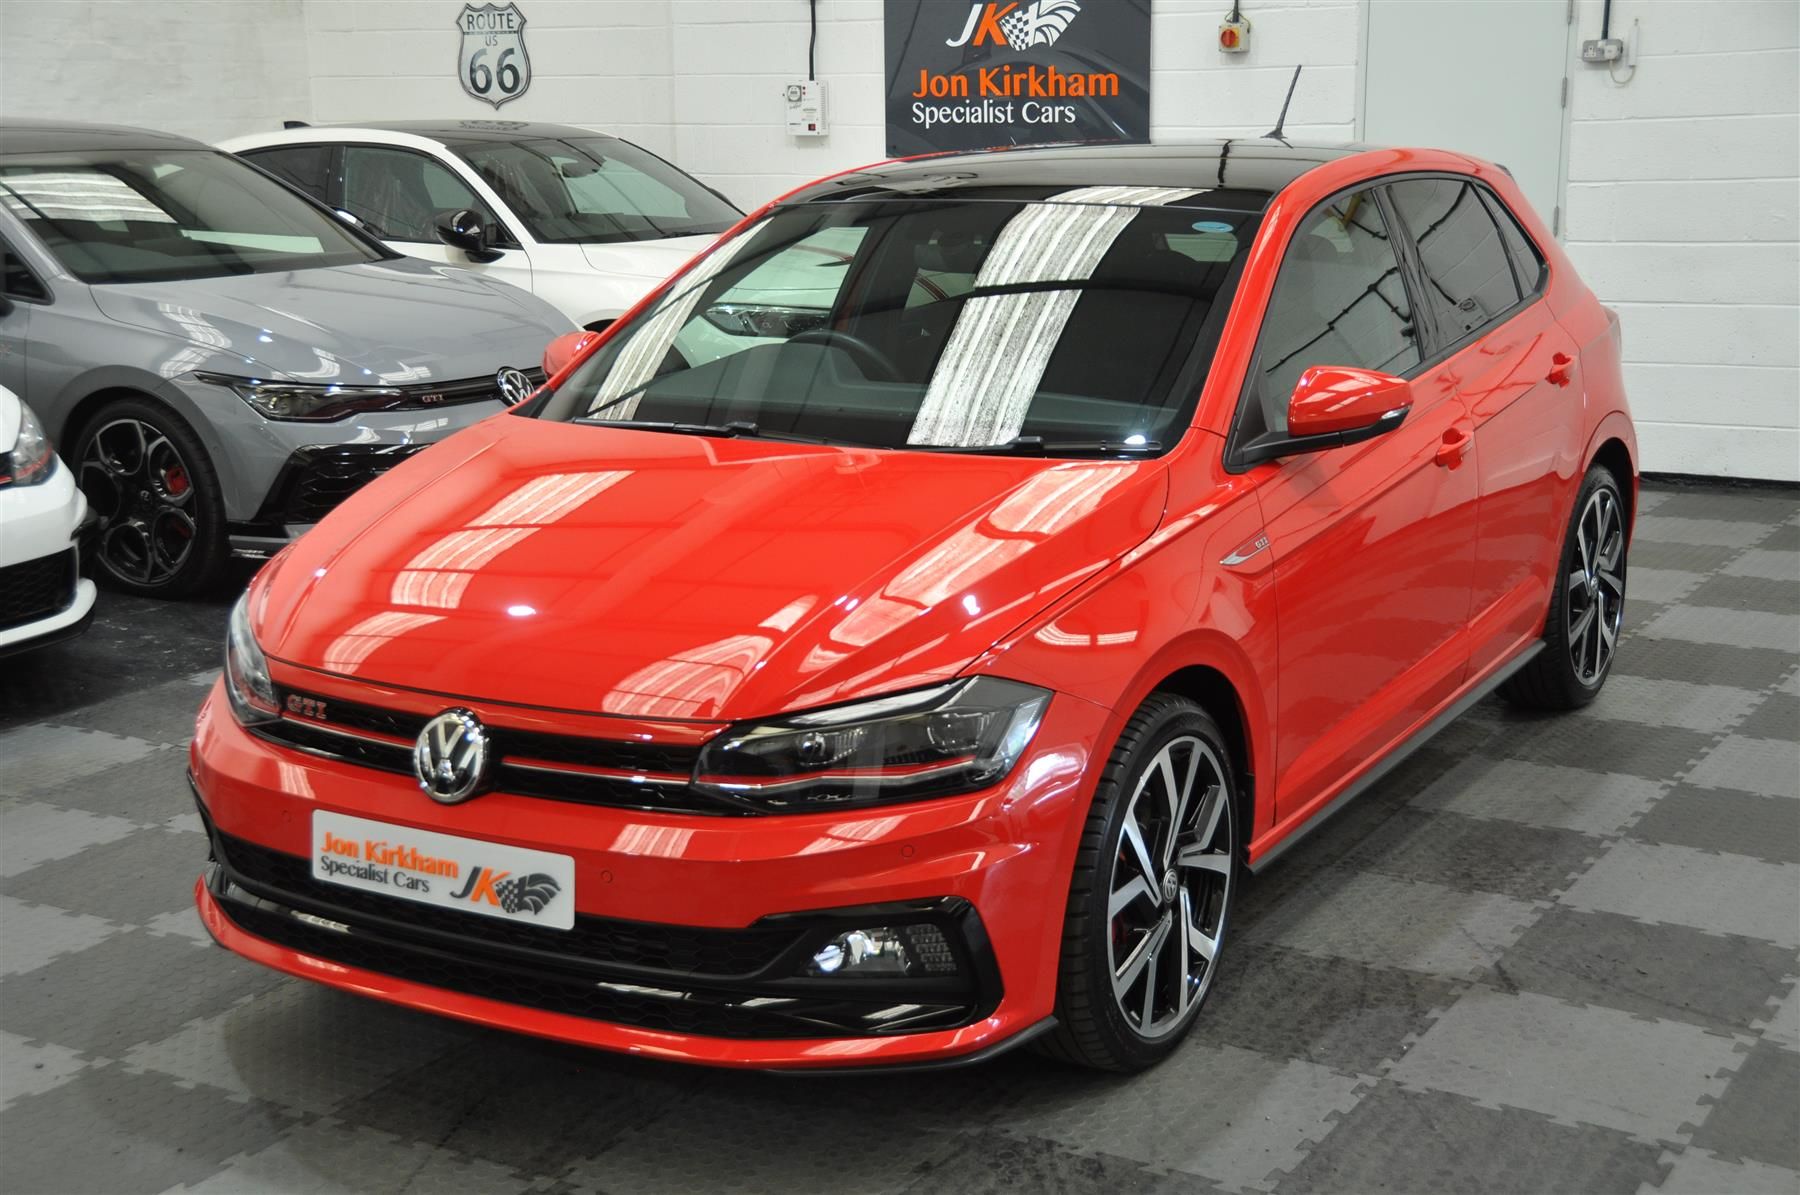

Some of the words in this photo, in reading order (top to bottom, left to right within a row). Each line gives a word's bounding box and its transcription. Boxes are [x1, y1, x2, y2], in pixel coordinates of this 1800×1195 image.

[466, 13, 515, 30] ROUTE
[945, 2, 1018, 48] JK
[484, 35, 498, 46] US
[469, 47, 520, 94] 66
[912, 69, 968, 98] Jon
[980, 65, 1119, 97] Kirkham
[912, 100, 1014, 129] Specialist
[1022, 101, 1076, 124] Cars
[422, 394, 444, 403] GTI
[1255, 536, 1268, 549] GTI
[287, 694, 328, 719] GTI
[320, 832, 360, 858] Jon
[364, 840, 459, 879] Kirkham
[320, 855, 389, 884] Specialist
[393, 871, 430, 893] Cars
[449, 866, 511, 906] JK
